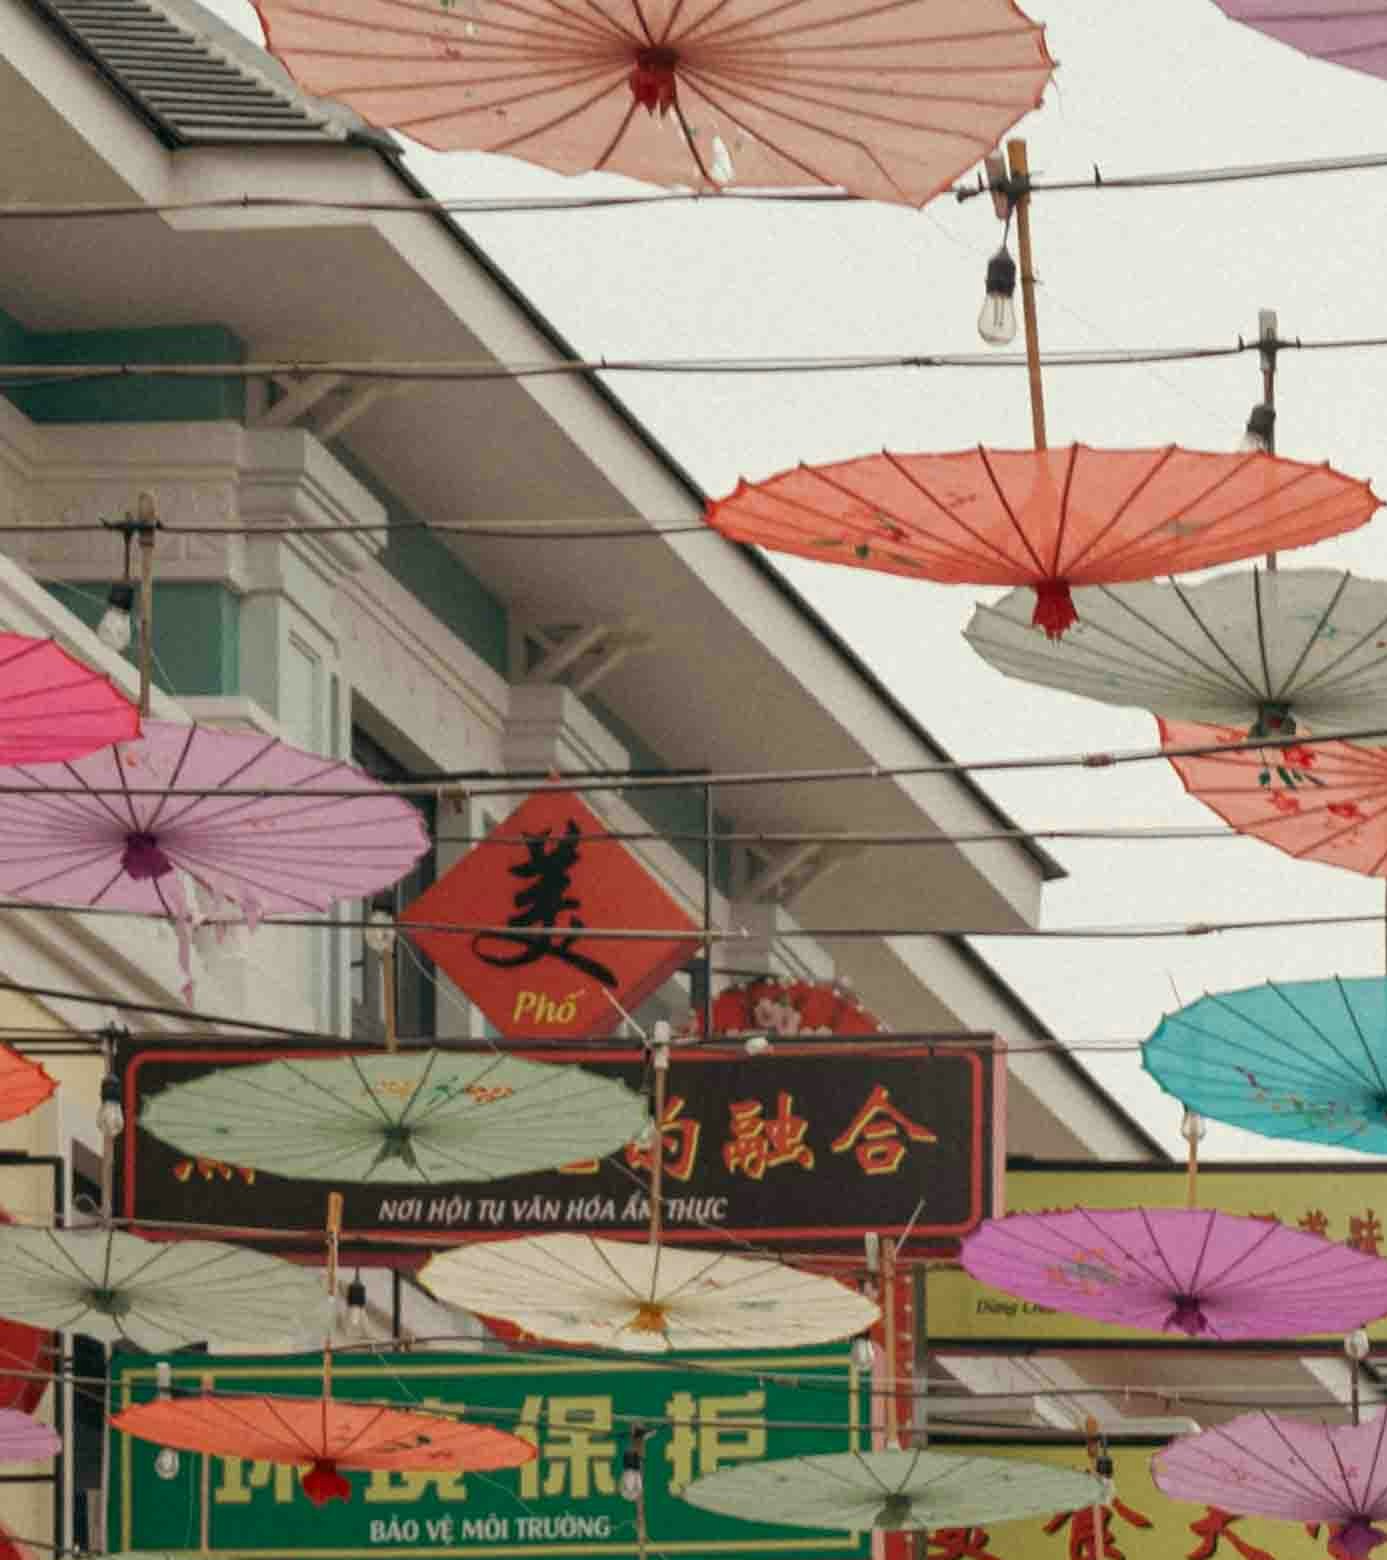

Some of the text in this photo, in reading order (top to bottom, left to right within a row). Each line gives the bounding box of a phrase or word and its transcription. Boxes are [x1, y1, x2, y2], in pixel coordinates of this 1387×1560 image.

[512, 991, 577, 1025] Phố
[378, 1197, 421, 1222] NƠI
[427, 1194, 472, 1225] HỘI
[478, 1198, 506, 1225] TỤ
[511, 1194, 559, 1222] VĂN
[566, 1193, 617, 1222] HÓA
[666, 1195, 730, 1224] THỰC
[369, 1509, 612, 1544] BẢO VỆ MÔI TRƯỜNG
